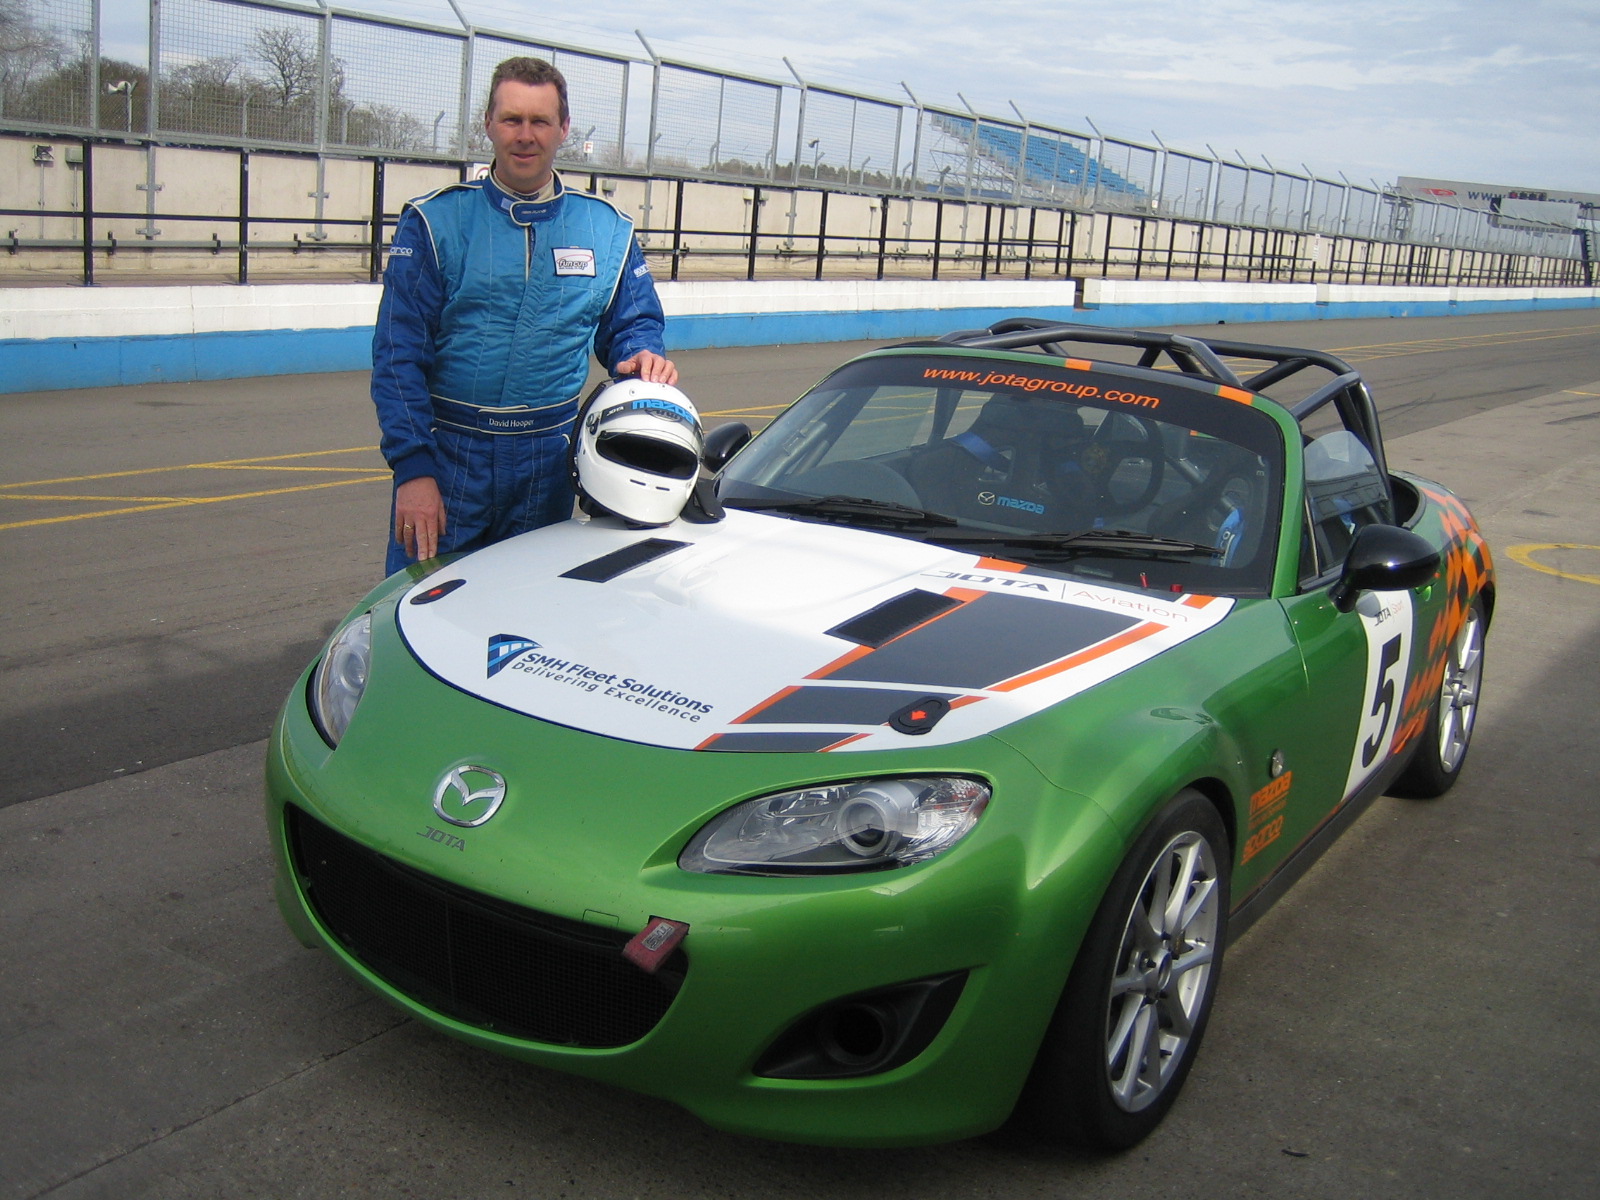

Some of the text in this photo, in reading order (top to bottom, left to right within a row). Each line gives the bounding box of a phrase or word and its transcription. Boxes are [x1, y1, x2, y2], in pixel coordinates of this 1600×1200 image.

[922, 366, 1161, 409] www.jotagroup.com
[488, 418, 535, 428] David Hooper
[920, 571, 1049, 592] JOTA
[1073, 590, 1188, 622] Aviation
[511, 661, 701, 722] Delivering Excellence
[521, 652, 714, 713] SMH Fleet Solutions
[1362, 633, 1401, 768] 5
[416, 825, 465, 851] JOTA
